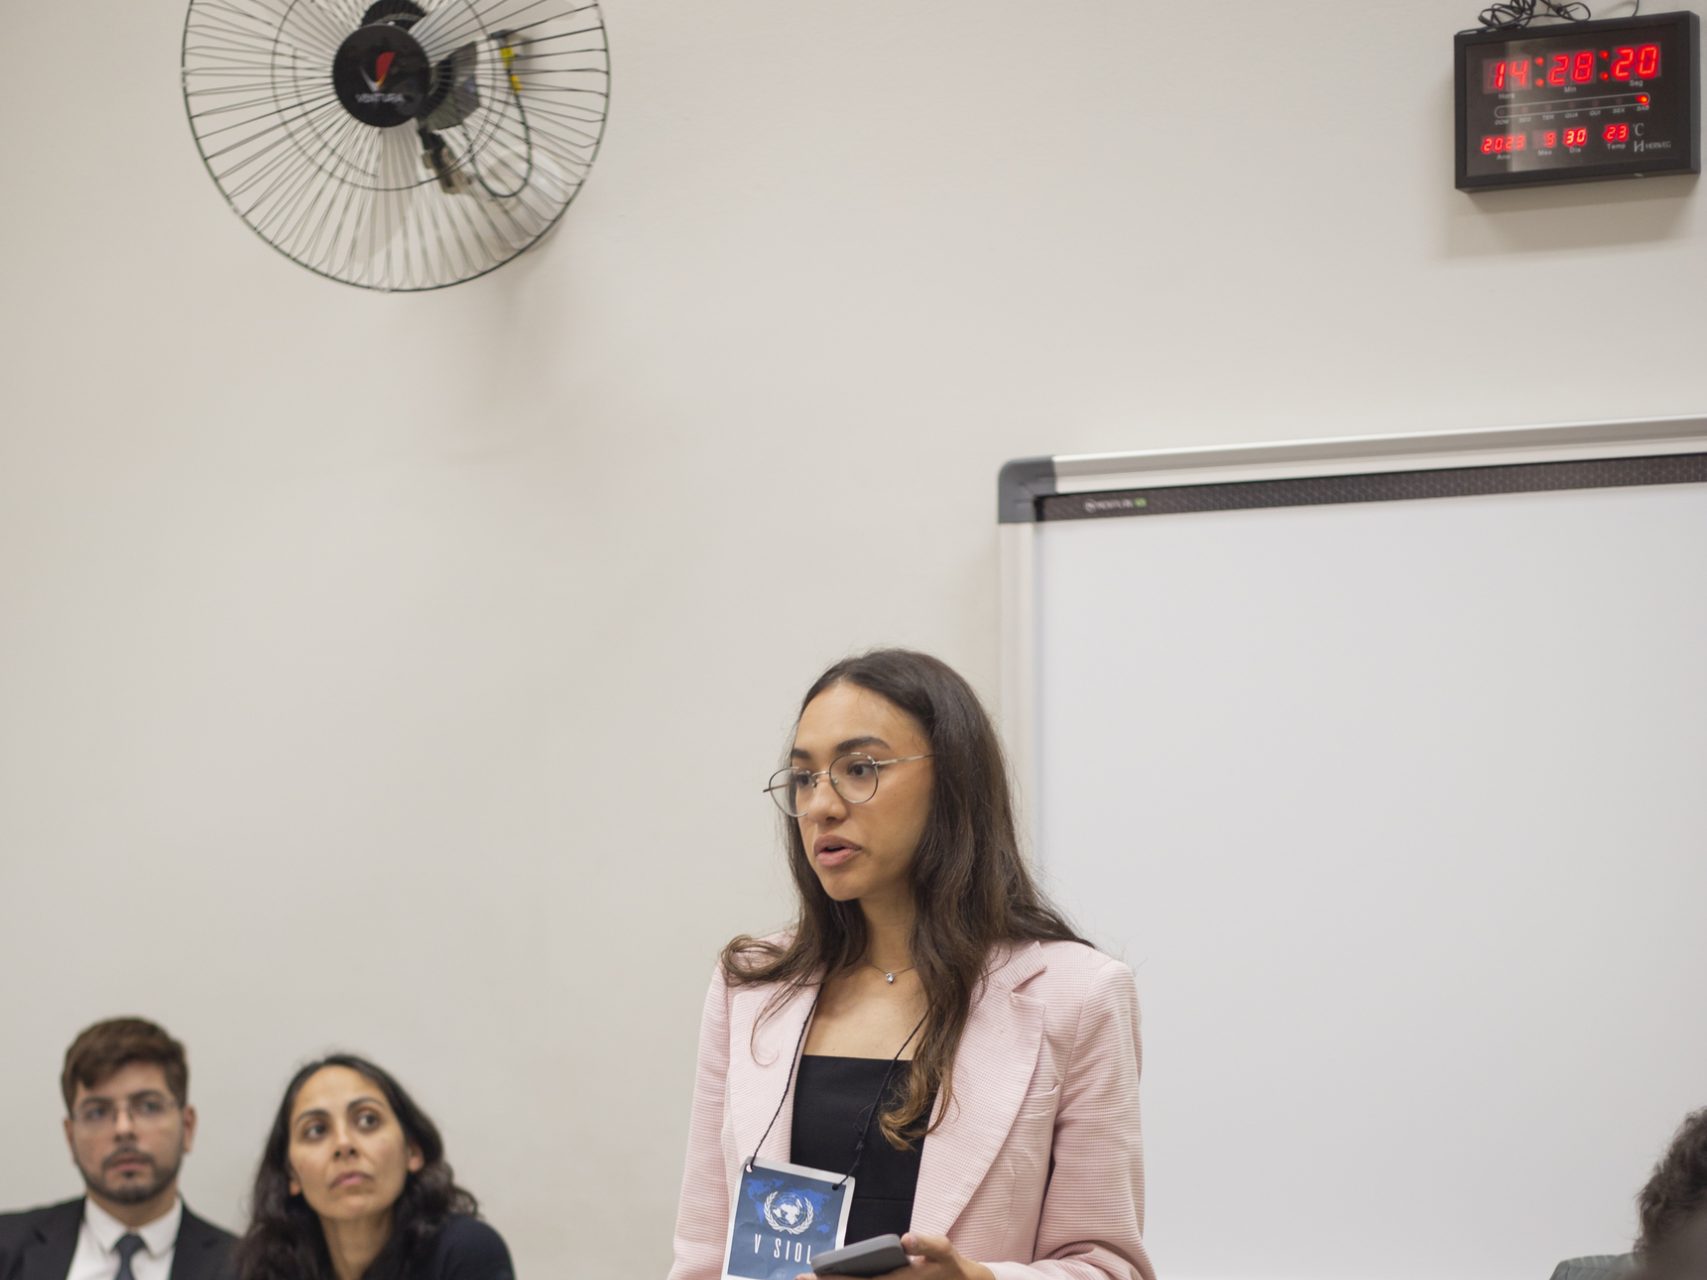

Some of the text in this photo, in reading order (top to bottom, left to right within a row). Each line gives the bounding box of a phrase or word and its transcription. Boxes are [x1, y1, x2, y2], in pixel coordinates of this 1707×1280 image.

[1492, 43, 1660, 90] 14:28:20
[1481, 132, 1526, 154] 2023
[1564, 127, 1587, 147] 30
[1603, 123, 1629, 143] 23
[754, 1233, 762, 1254] V
